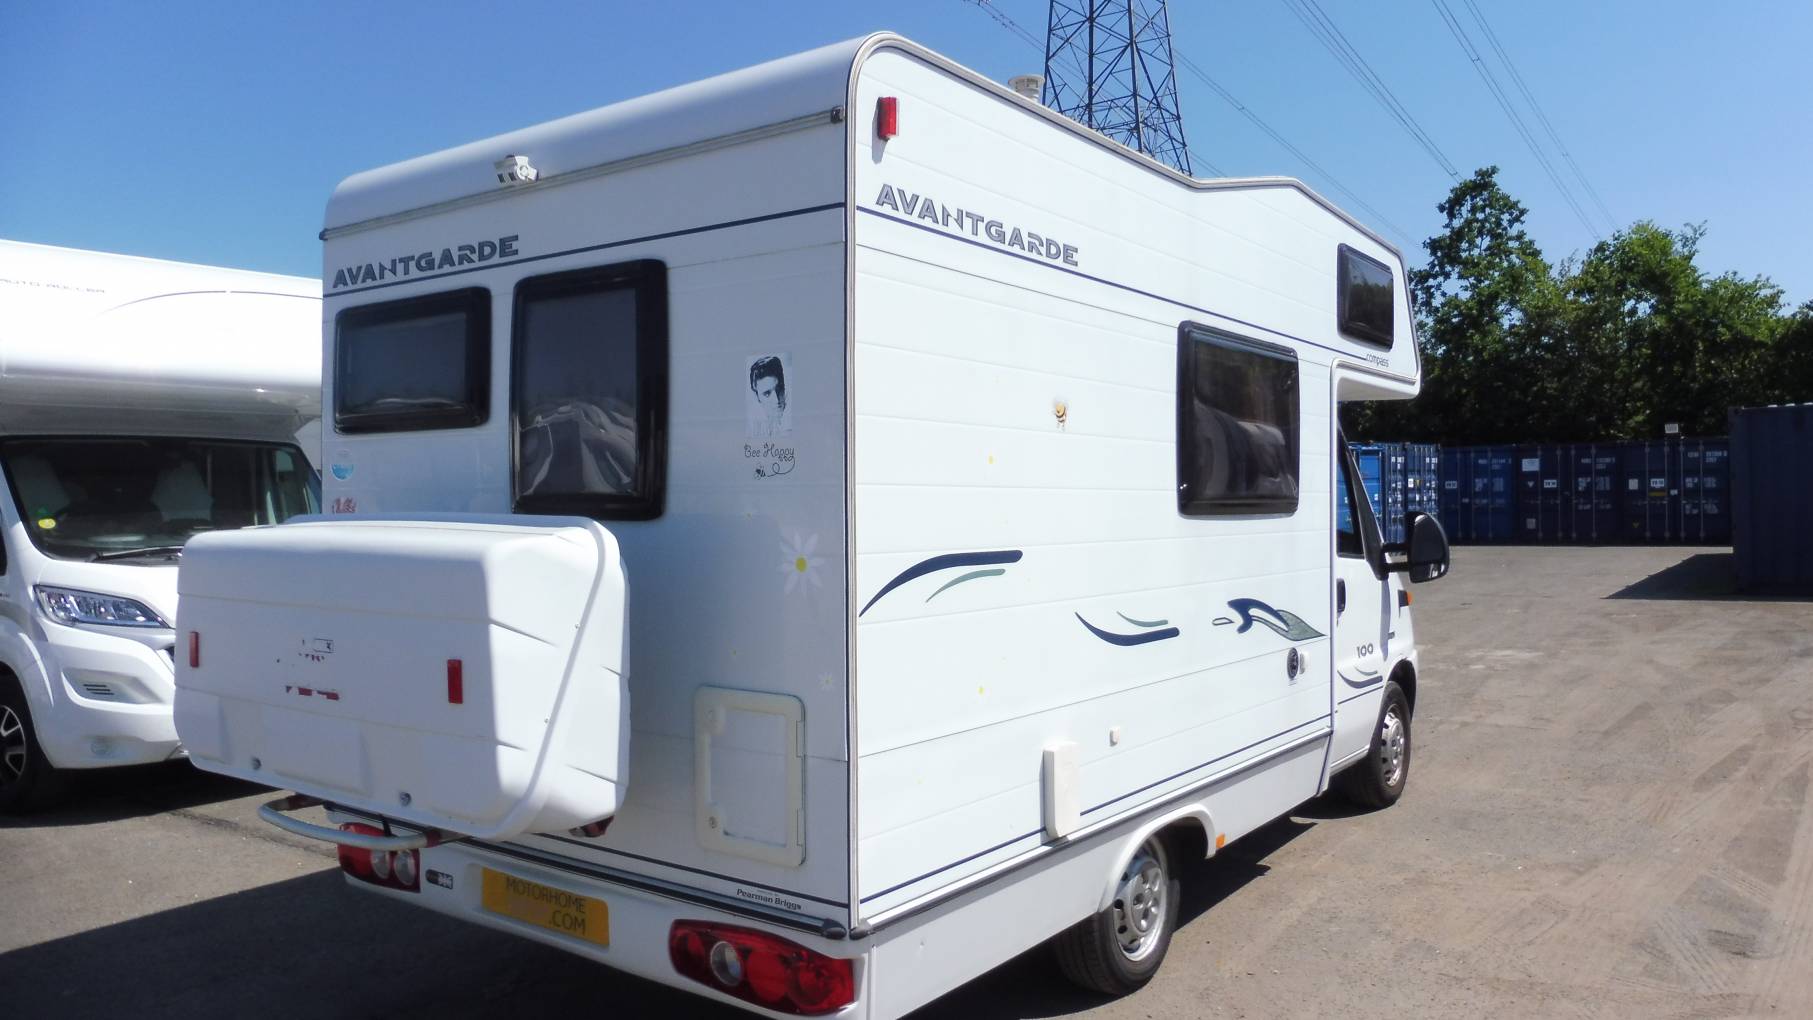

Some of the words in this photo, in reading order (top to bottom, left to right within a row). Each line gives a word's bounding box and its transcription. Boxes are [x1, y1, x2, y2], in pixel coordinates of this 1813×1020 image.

[876, 184, 1078, 267] AVANTGARDE
[333, 235, 519, 288] AVANTGARDE
[744, 443, 760, 458] Bee
[1357, 643, 1374, 658] 100
[506, 876, 586, 914] MOTORHOME
[737, 888, 773, 904] Pearman
[775, 897, 802, 910] Briggs
[549, 910, 586, 936] .COM
